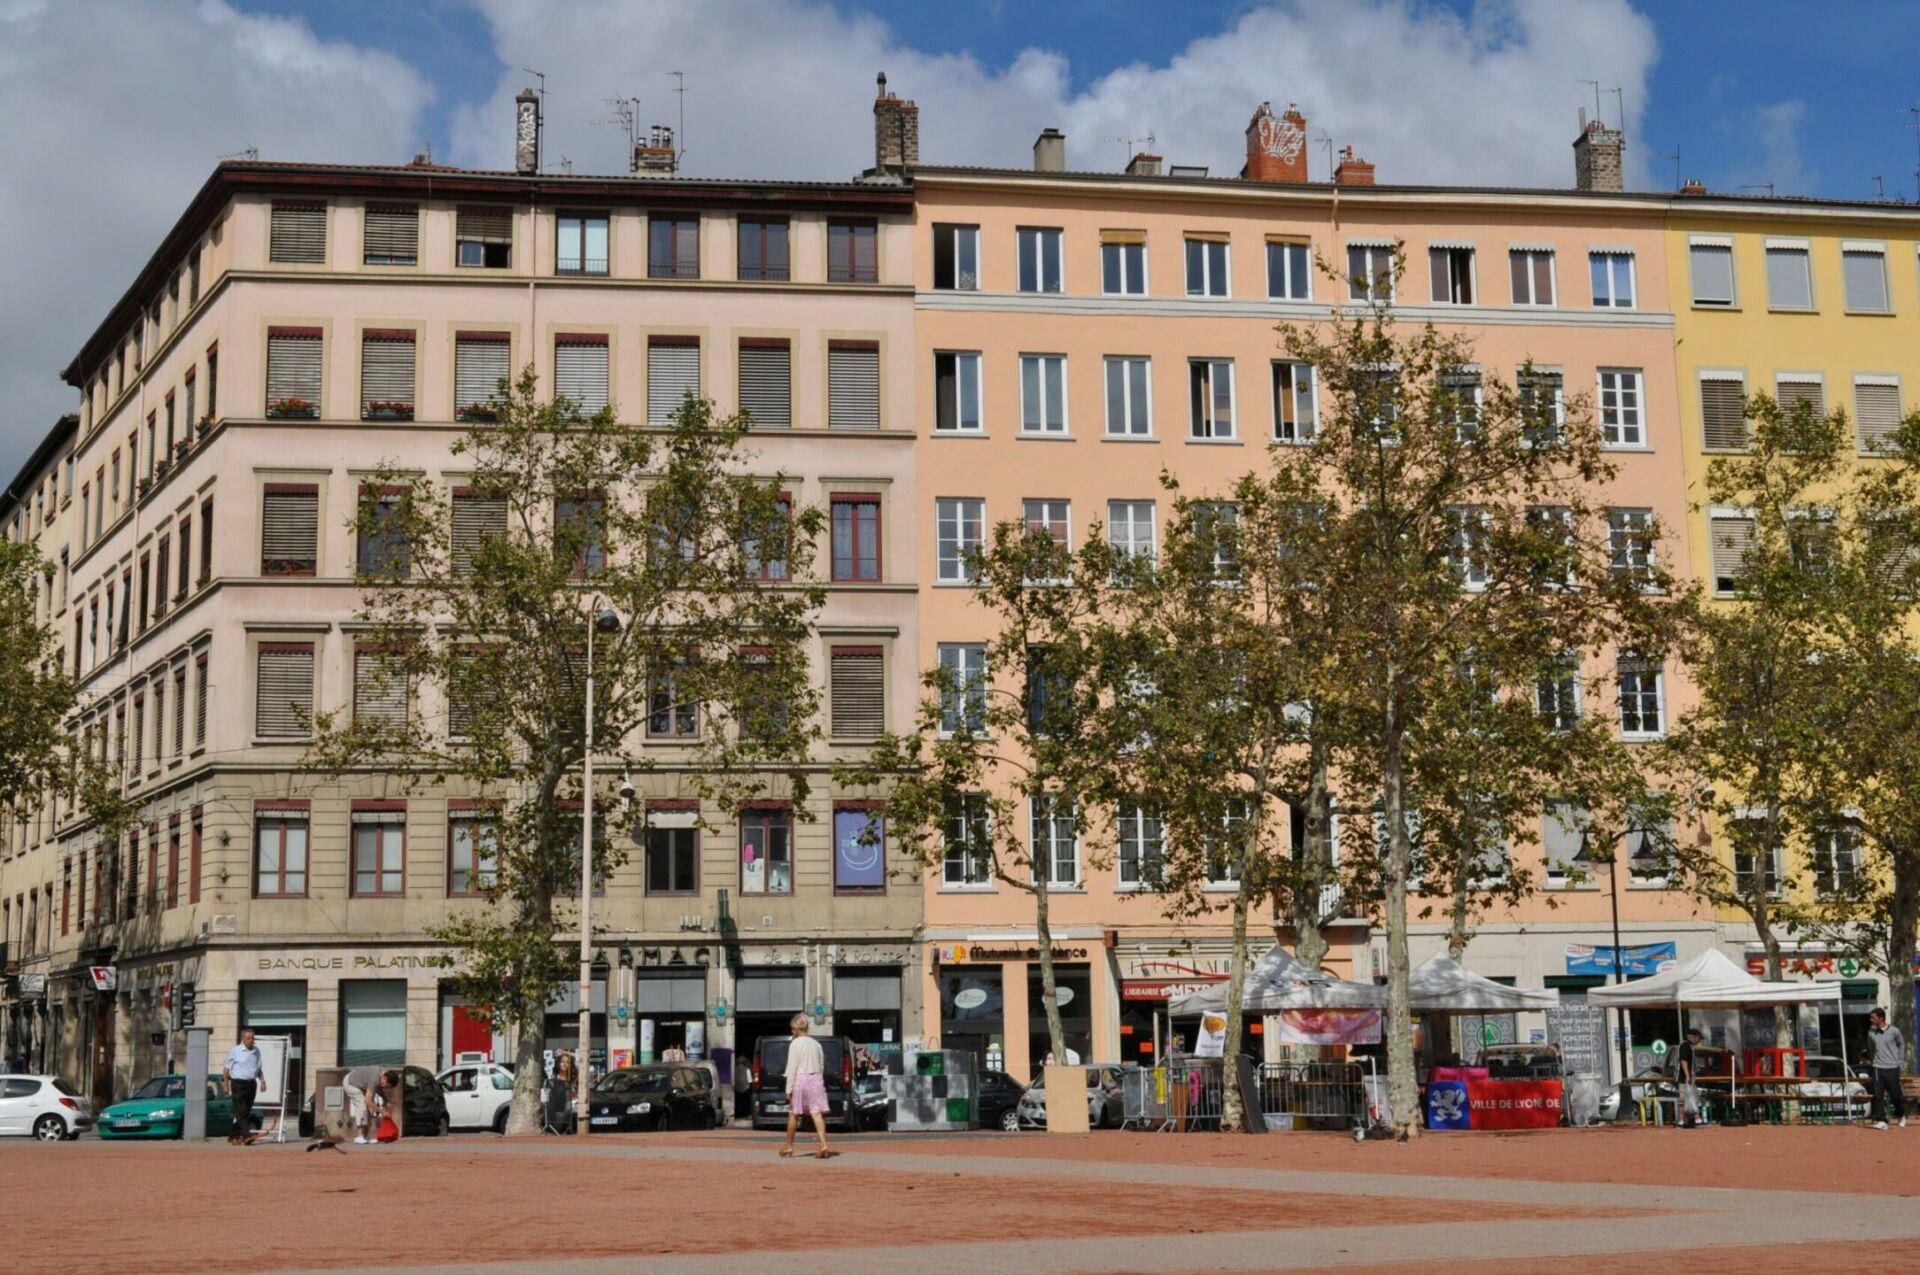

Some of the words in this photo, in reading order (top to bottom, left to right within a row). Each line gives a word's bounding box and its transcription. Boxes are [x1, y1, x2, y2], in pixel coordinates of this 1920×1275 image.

[969, 945, 1022, 959] Mutuelle
[258, 957, 343, 971] BANQUE
[1124, 987, 1161, 997] LIBRAIRIE
[1469, 1099, 1497, 1110] VILLE
[1499, 1099, 1512, 1109] DE
[1514, 1098, 1543, 1109] LYON
[1546, 1098, 1561, 1109] DE
